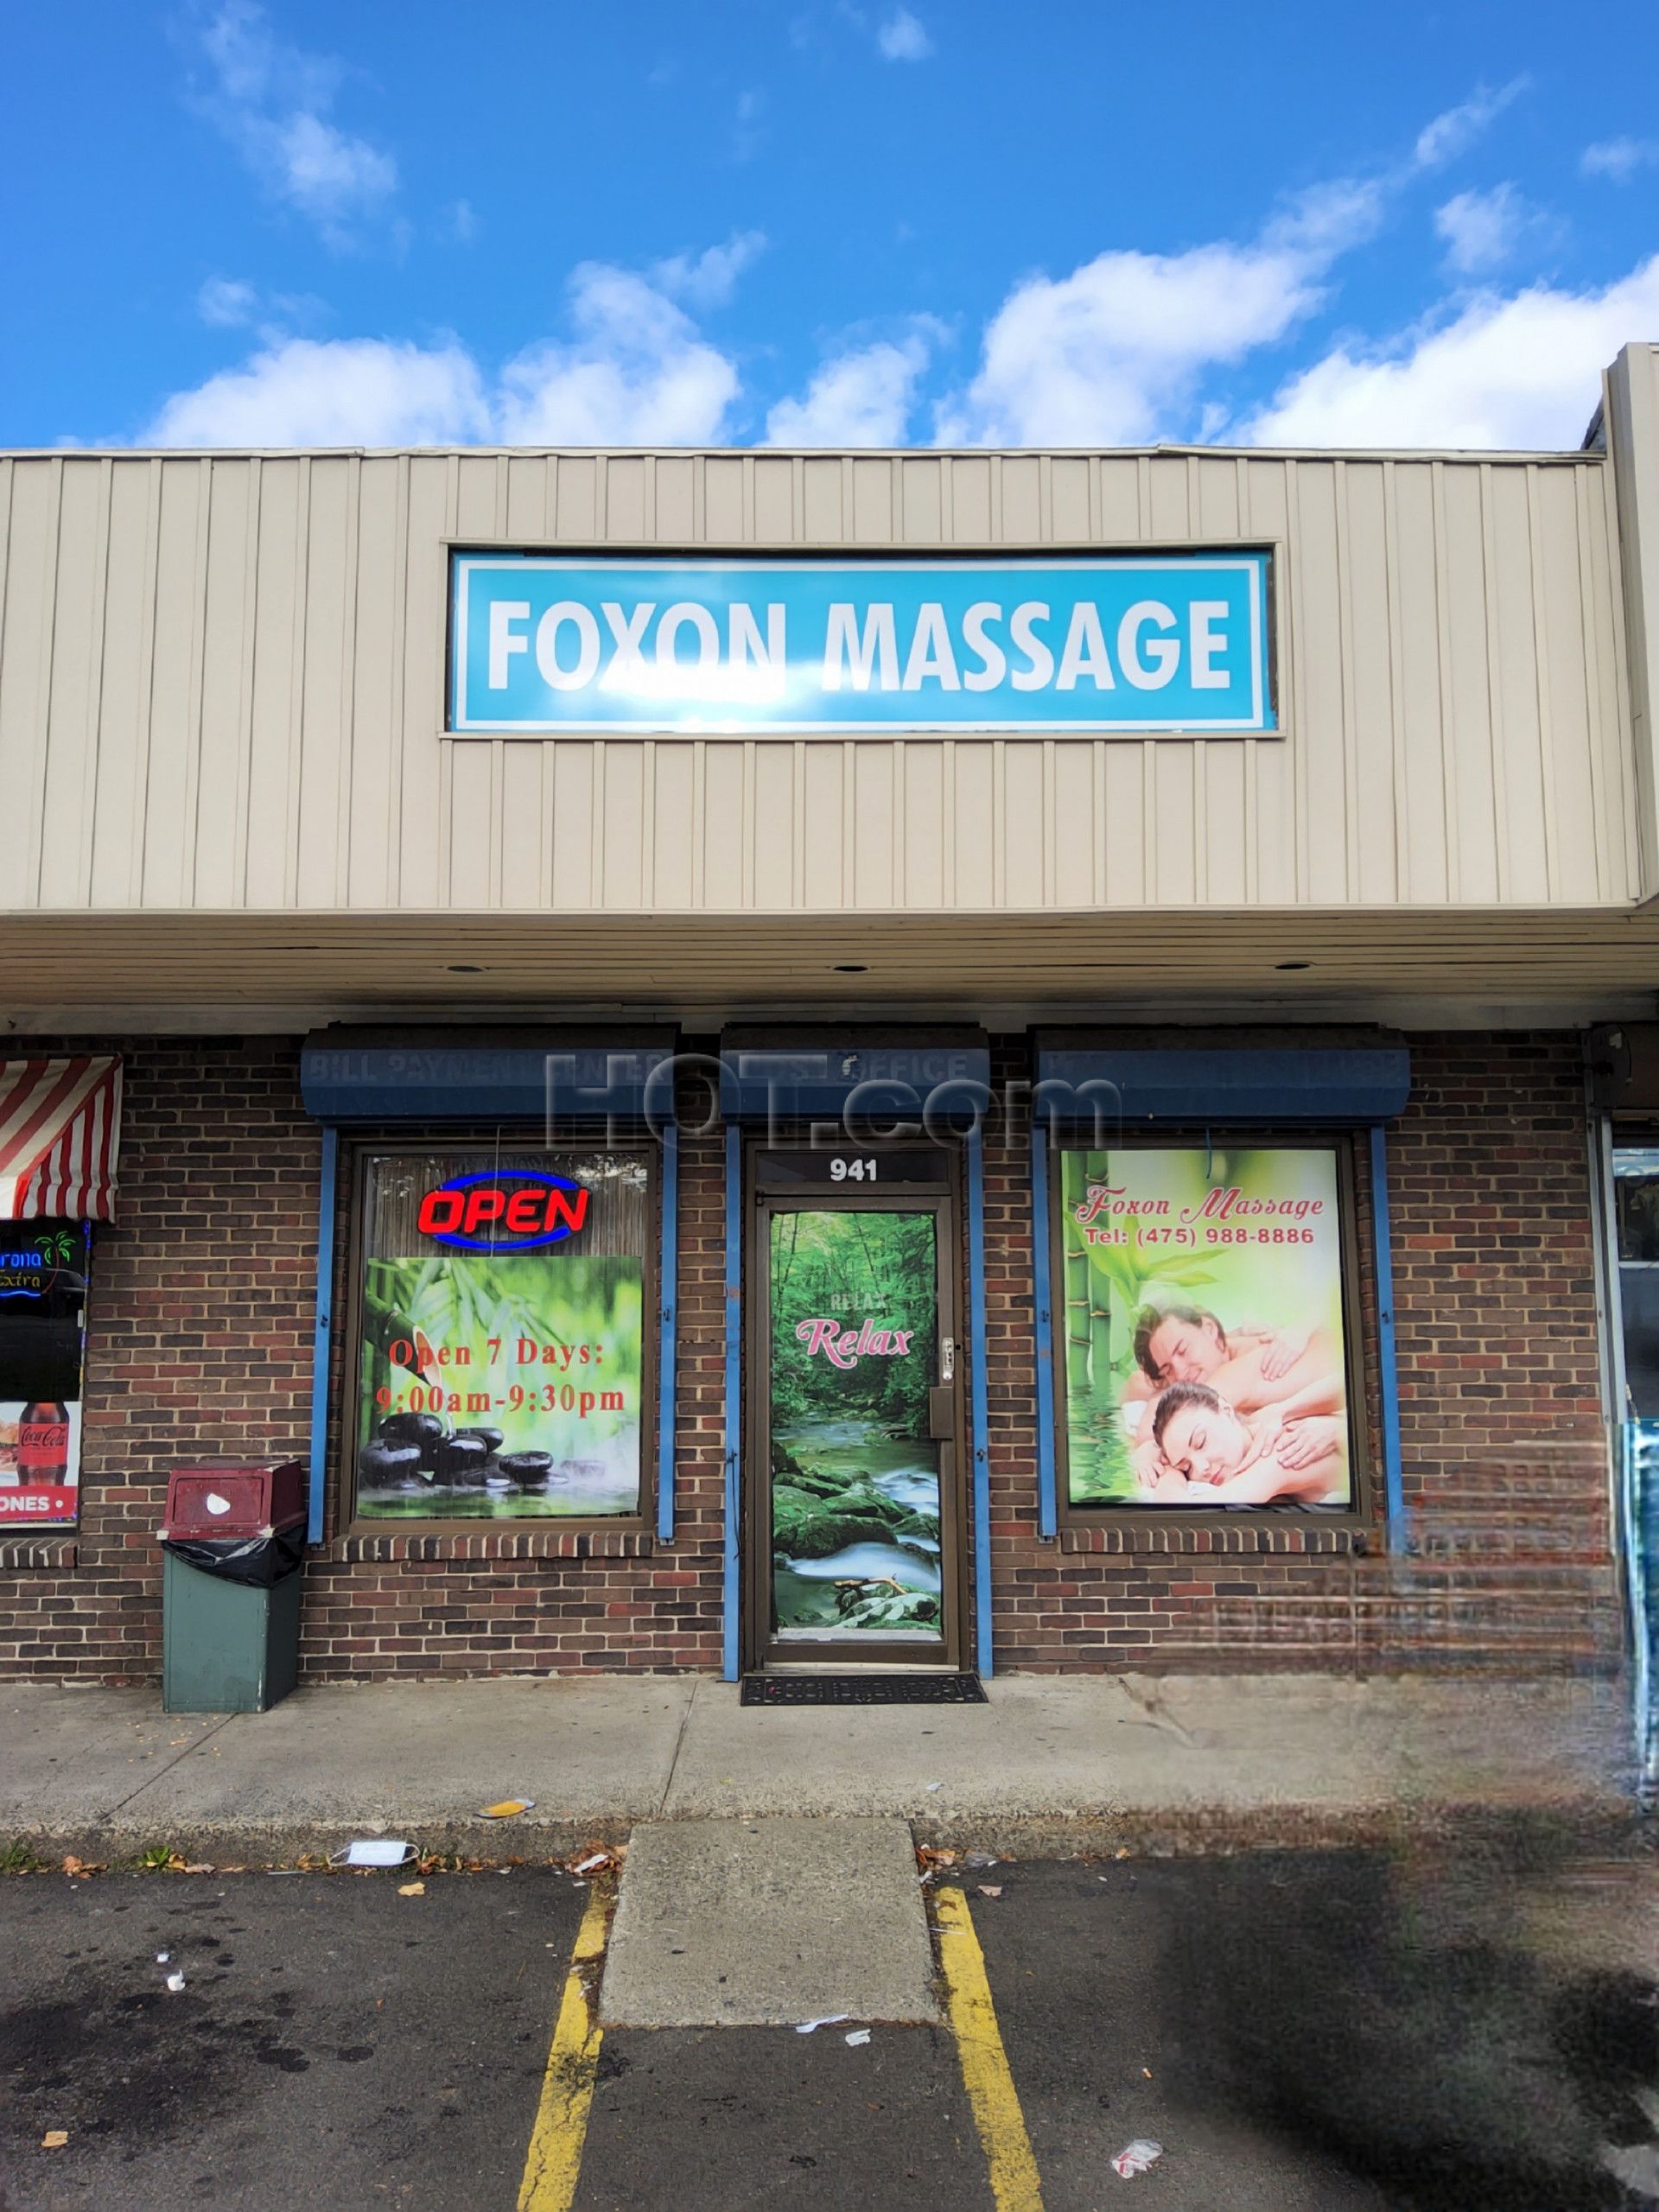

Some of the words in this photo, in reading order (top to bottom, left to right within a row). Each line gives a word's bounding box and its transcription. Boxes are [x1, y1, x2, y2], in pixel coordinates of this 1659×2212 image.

[488, 600, 786, 691] FOXON
[821, 600, 1230, 691] MASSAGE
[310, 1054, 378, 1080] BILL
[830, 1159, 877, 1181] 941
[418, 1188, 588, 1234] OPEN
[1076, 1185, 1170, 1224] Foxon
[1179, 1187, 1324, 1224] Massage
[1084, 1228, 1127, 1244] Tel:
[1137, 1227, 1197, 1247] (475)
[1206, 1227, 1314, 1244] 988-8886
[389, 1339, 471, 1373] Open
[486, 1338, 502, 1365] 7
[516, 1338, 603, 1372] Days:
[796, 1319, 914, 1369] Relax
[376, 1384, 625, 1418] 9:00am-9:30pm
